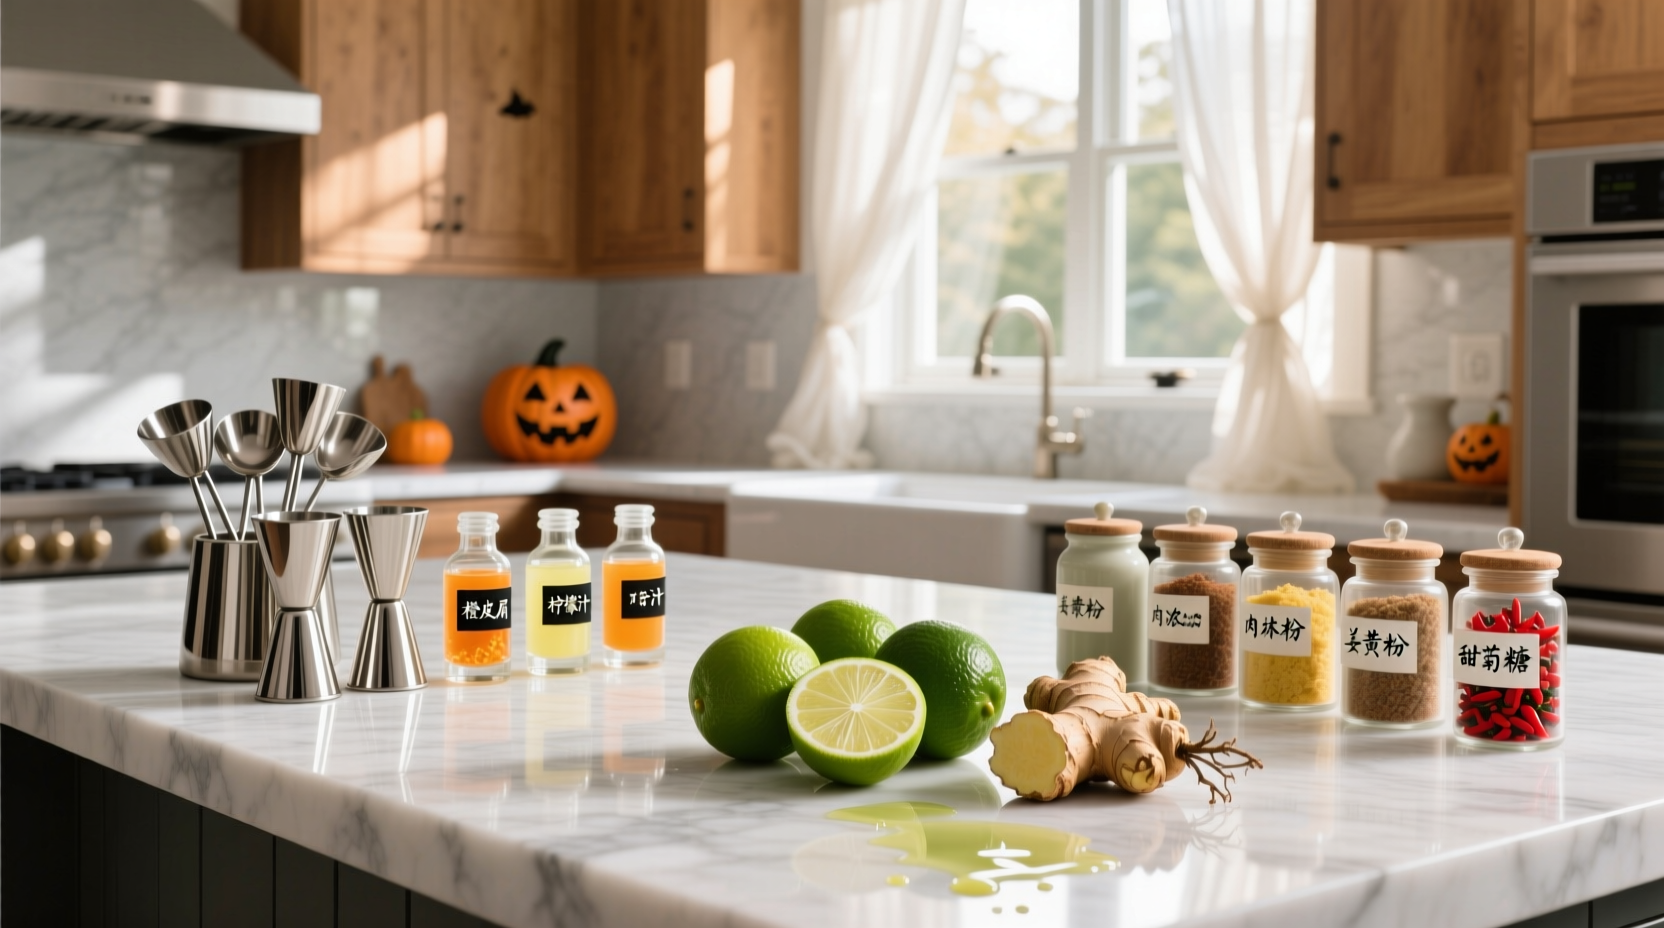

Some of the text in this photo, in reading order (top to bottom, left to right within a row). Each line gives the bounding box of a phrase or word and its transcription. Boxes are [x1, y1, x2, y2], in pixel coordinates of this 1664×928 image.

[1344, 627, 1410, 658] 姜黄粉
[1458, 644, 1532, 673] 甜菊糖
